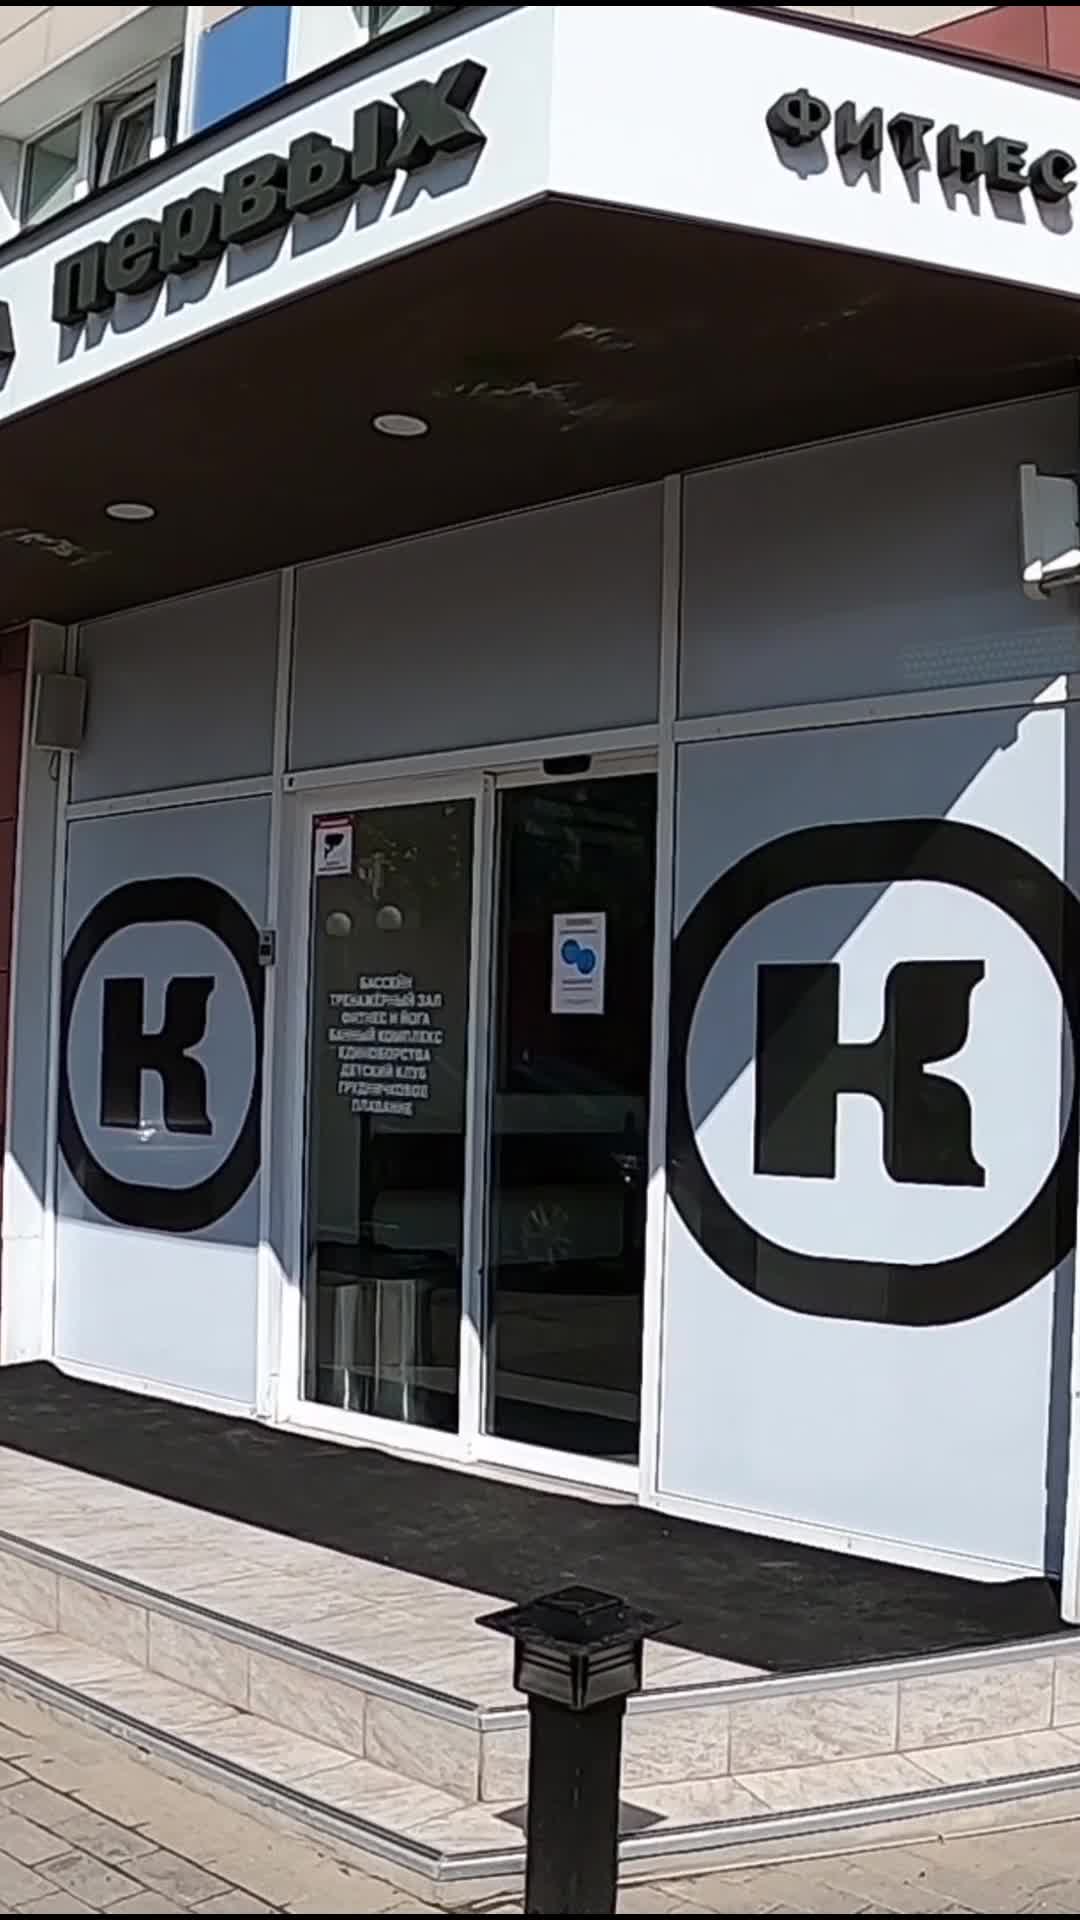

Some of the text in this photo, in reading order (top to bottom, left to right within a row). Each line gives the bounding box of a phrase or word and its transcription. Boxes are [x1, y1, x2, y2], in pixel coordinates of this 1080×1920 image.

[765, 87, 1078, 204] ФИТНЕС
[359, 973, 413, 990] БАССЕЙН
[417, 993, 442, 1008] ЗАЛ
[341, 1009, 431, 1026] ФИТНЕС И ЙОГА
[377, 1029, 443, 1044] КОМПЛЕКС
[340, 1062, 427, 1080] ДЕТСКИЙ КЛУБ
